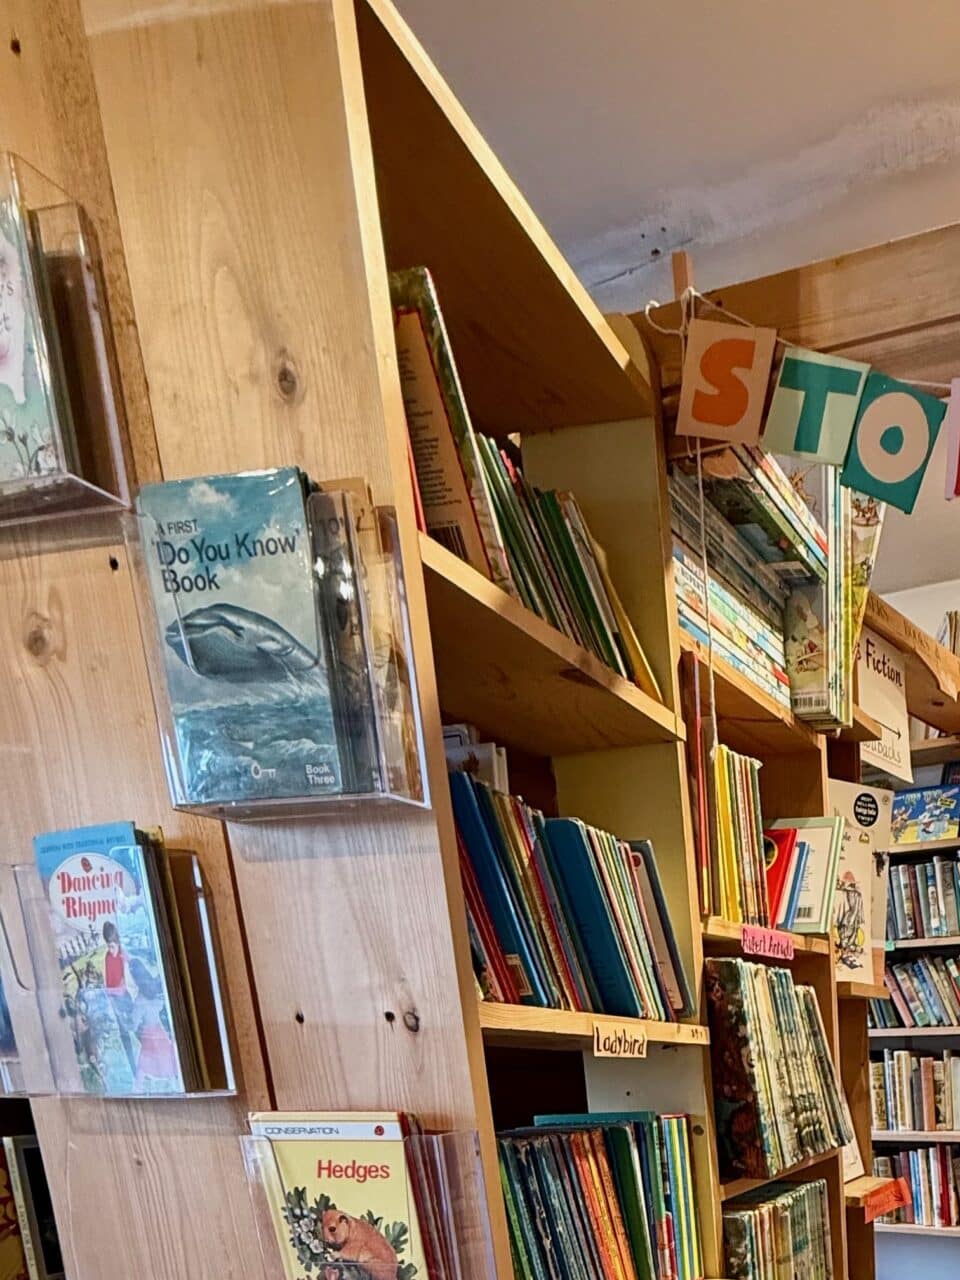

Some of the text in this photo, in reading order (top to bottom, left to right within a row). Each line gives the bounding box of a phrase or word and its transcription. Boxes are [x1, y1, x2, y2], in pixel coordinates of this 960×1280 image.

[168, 519, 198, 535] FIRST
[191, 538, 230, 563] You
[161, 568, 220, 593] Book
[865, 637, 903, 687] Fiction
[306, 764, 330, 774] Book
[308, 775, 335, 785] Three
[57, 867, 124, 894] Dancing
[595, 1026, 645, 1055] Ladybird
[264, 1127, 340, 1135] CONSERVATION
[317, 1160, 390, 1183] Hedges
